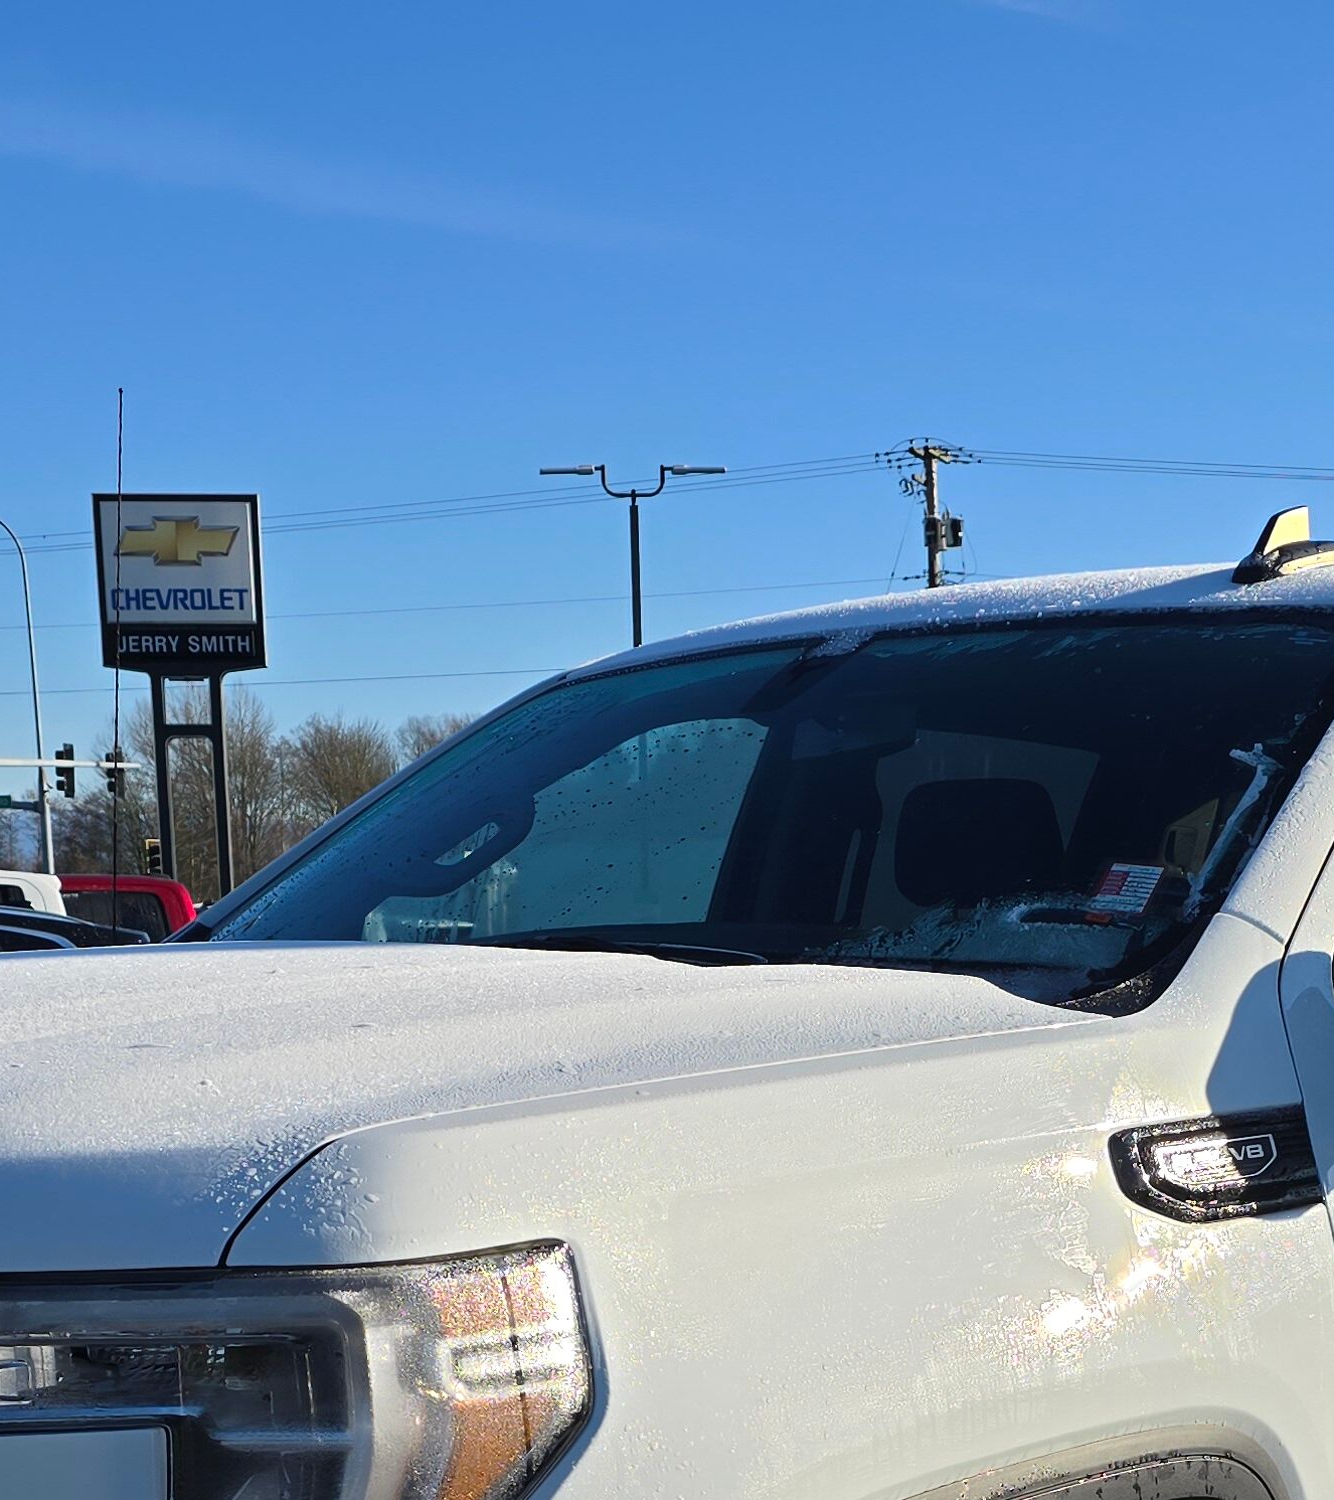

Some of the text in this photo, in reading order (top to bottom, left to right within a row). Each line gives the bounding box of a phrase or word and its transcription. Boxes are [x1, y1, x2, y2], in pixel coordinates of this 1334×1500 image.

[111, 588, 248, 611] CHEVROLET
[118, 635, 251, 654] JERRY SMITH
[1227, 1144, 1265, 1161] V8
